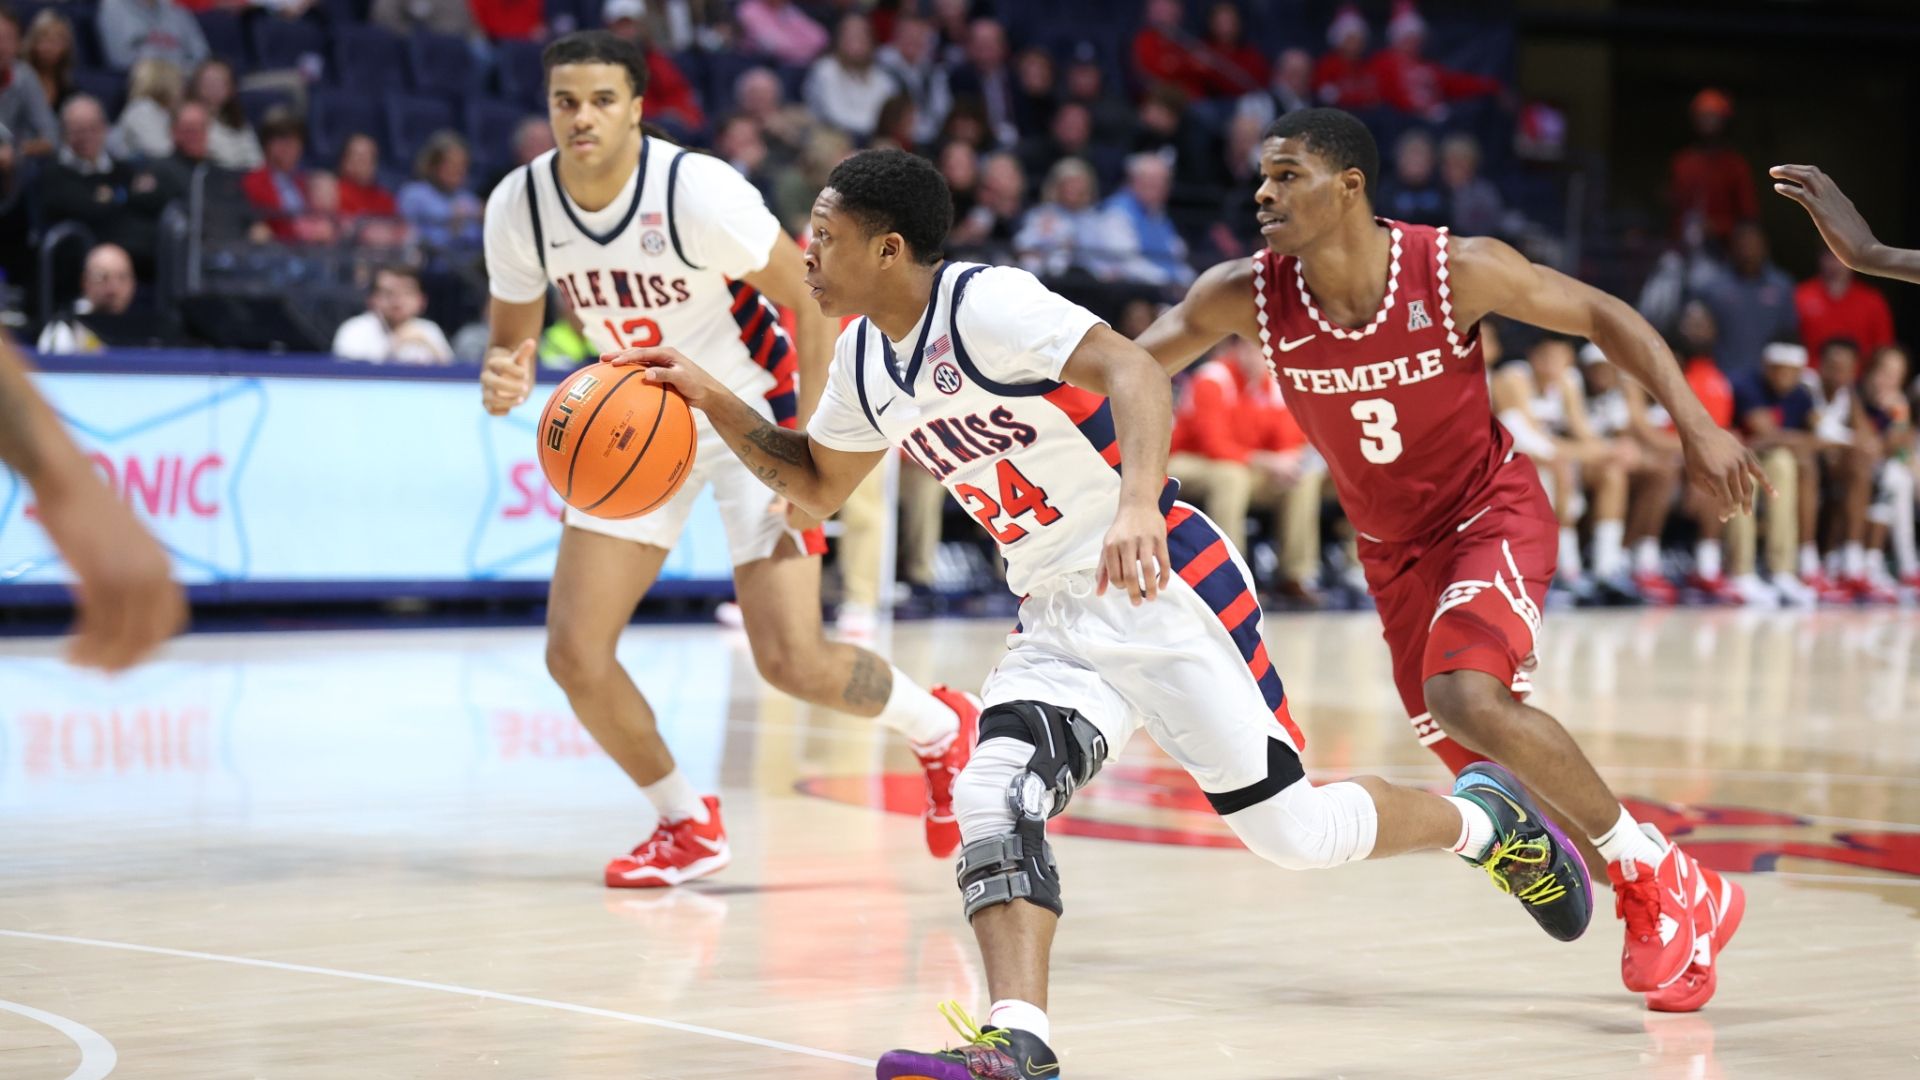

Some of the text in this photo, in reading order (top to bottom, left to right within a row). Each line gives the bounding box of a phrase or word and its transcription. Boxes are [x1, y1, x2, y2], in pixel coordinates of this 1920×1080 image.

[610, 270, 691, 309] MISS
[603, 317, 663, 349] 12
[934, 361, 962, 395] SEC
[1283, 348, 1444, 394] TEMPLE
[546, 374, 600, 452] ELITE
[926, 404, 1038, 463] MISS
[1350, 397, 1404, 464] 3
[954, 458, 1064, 545] 24
